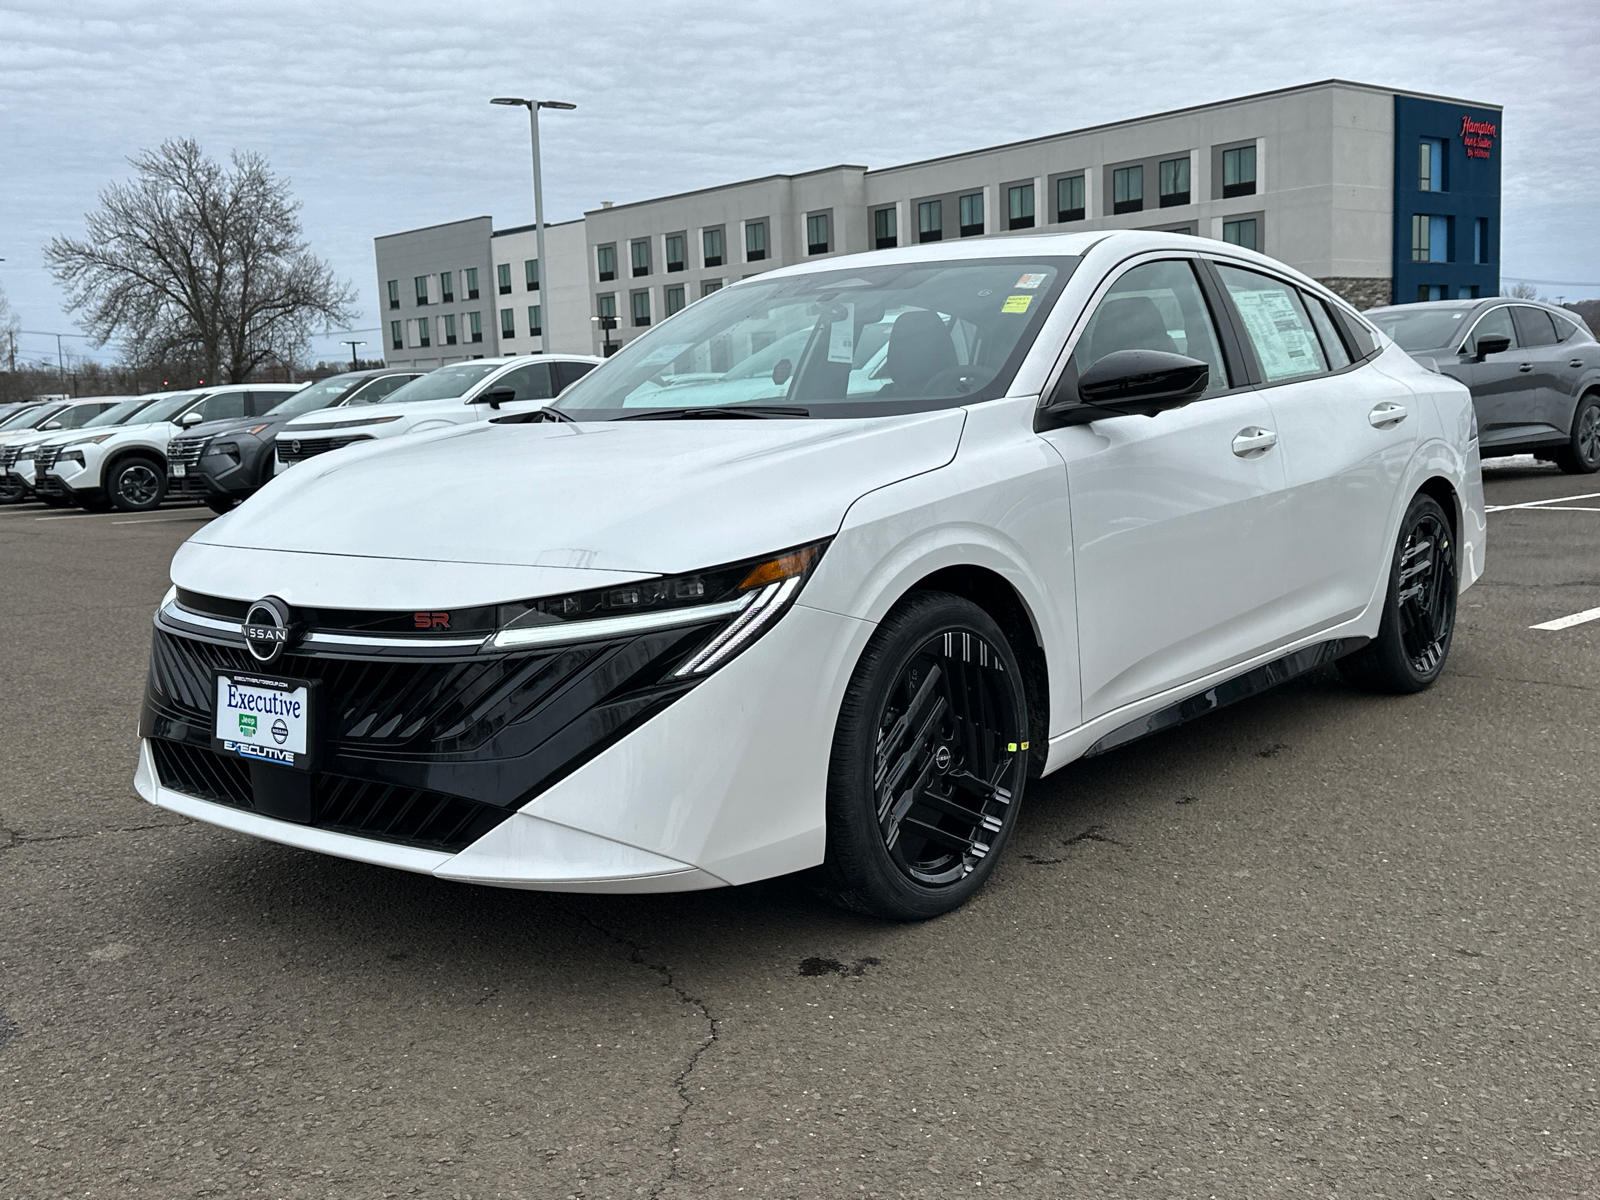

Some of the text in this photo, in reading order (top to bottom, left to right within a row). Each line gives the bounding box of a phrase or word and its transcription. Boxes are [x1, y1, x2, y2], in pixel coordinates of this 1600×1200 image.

[1460, 116, 1497, 138] Hampton
[413, 612, 451, 628] SR
[241, 626, 286, 640] NISSAN
[227, 684, 301, 719] Executive
[241, 716, 256, 726] Jeep
[272, 728, 288, 736] NISSAN
[223, 740, 295, 763] EXECUTIVE
